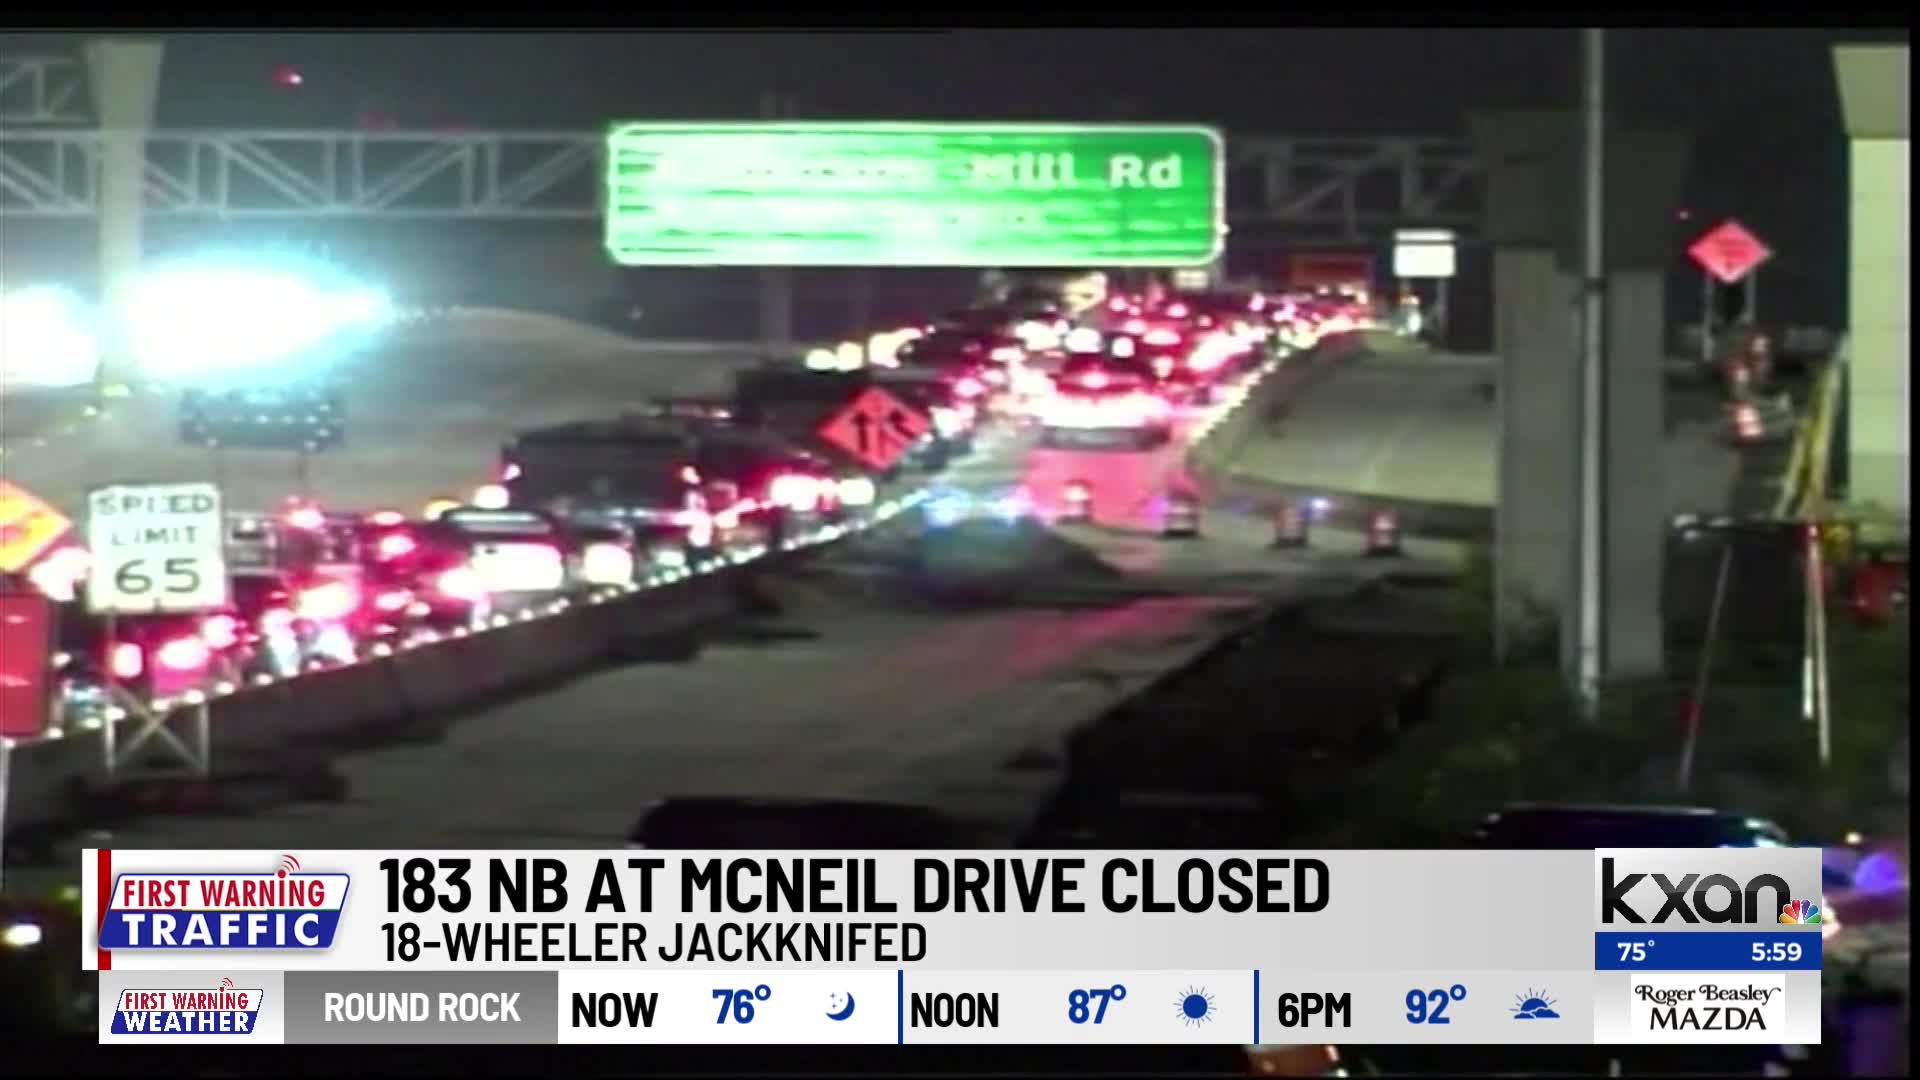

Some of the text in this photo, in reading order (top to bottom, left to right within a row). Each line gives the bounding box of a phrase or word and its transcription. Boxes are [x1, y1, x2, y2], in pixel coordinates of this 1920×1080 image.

[1110, 154, 1183, 189] Rd
[96, 493, 214, 515] SPEED
[110, 525, 199, 546] LIMIT
[114, 557, 201, 594] 65
